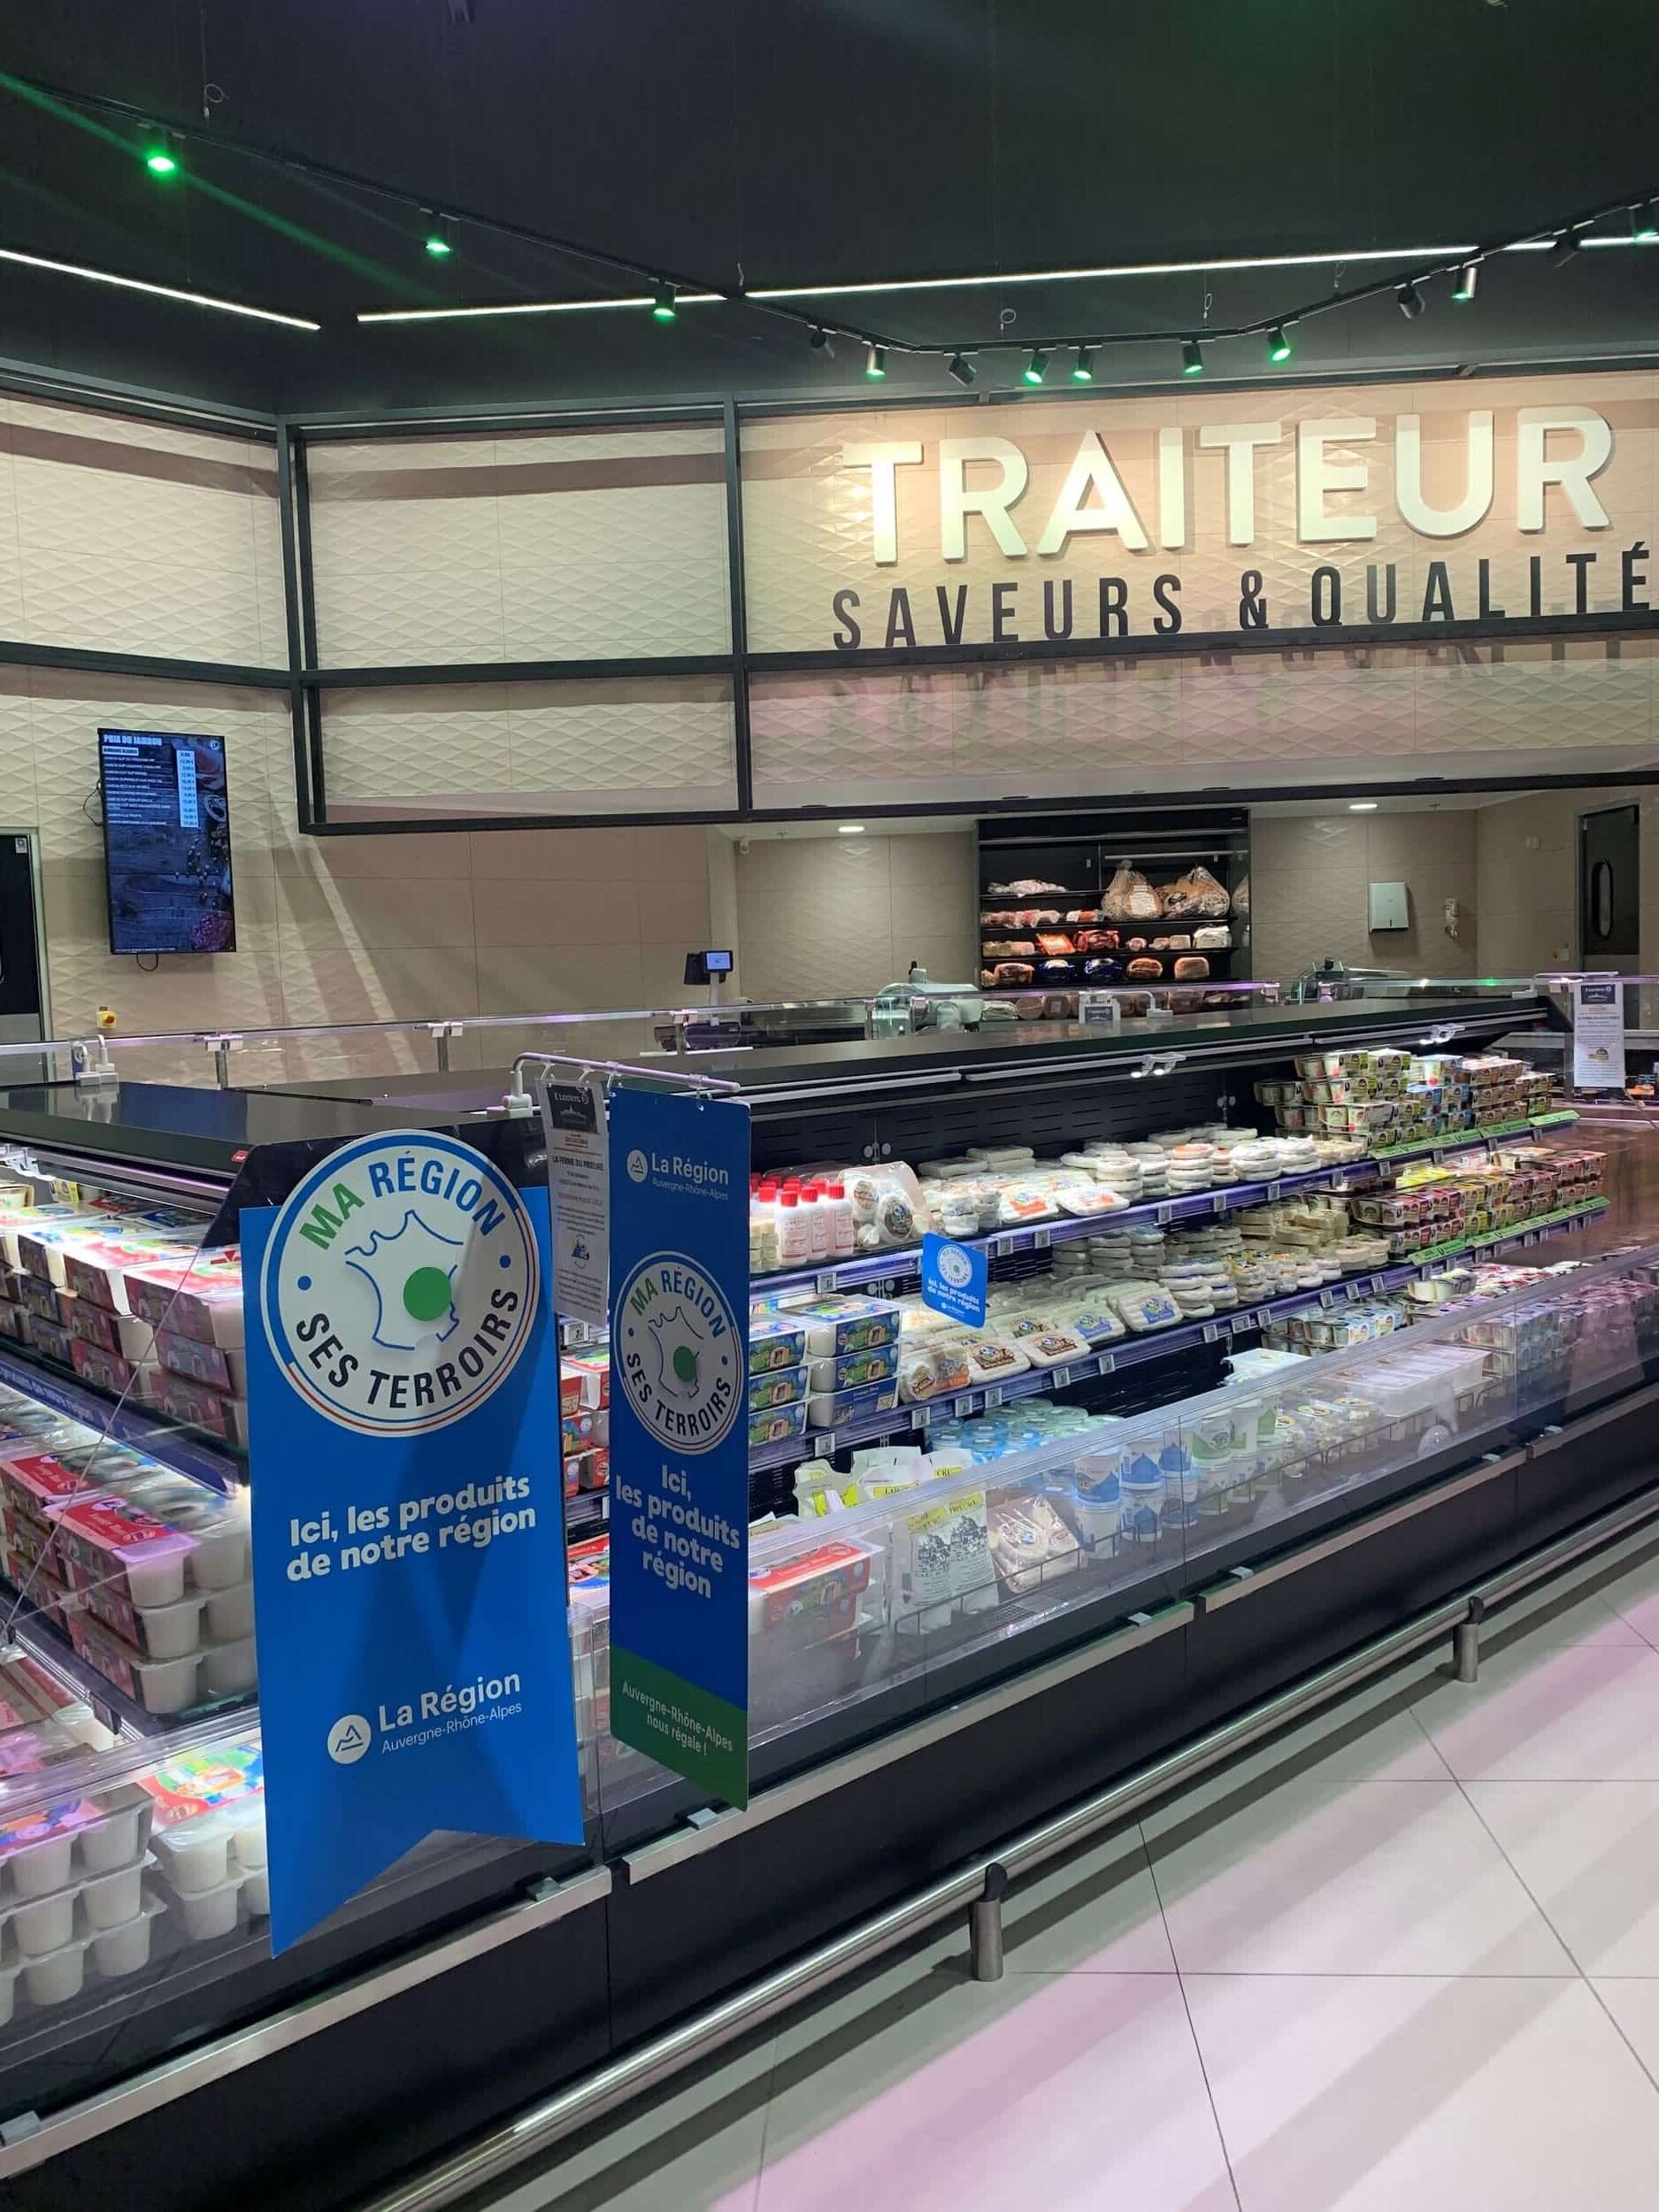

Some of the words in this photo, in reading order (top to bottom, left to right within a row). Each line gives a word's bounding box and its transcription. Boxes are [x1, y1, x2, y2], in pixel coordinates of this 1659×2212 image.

[843, 404, 1612, 565] TRAITEUR
[833, 573, 1182, 649] SAVEURS
[1240, 569, 1269, 630] &
[1311, 541, 1651, 626] QUALITÉ
[299, 1182, 365, 1251] MA
[368, 1149, 506, 1237] RÉGION
[651, 1152, 669, 1173] La
[672, 1156, 729, 1186] Région
[630, 1277, 659, 1317] MA
[660, 1265, 726, 1339] RÉGION
[296, 1313, 359, 1387] SES
[367, 1288, 518, 1409] TERROIRS
[626, 1352, 653, 1403] SES
[655, 1377, 732, 1437] TERROIRS
[289, 1510, 339, 1547] Ici,
[348, 1506, 390, 1534] les
[399, 1475, 531, 1531] produits
[616, 1474, 643, 1508] les
[648, 1494, 741, 1549] produits
[662, 1464, 692, 1502] Ici,
[286, 1551, 331, 1582] de
[341, 1532, 429, 1571] notre
[439, 1507, 536, 1548] région
[632, 1515, 659, 1544] de
[664, 1530, 724, 1572] notre
[642, 1549, 711, 1600] région
[378, 1703, 413, 1732] La
[420, 1673, 521, 1720] Région
[380, 1701, 523, 1755] Auvergne-Rhône-Alpes
[622, 1681, 733, 1752] Auvergne-Rhône-Alpes
[647, 1712, 669, 1735] nous
[671, 1727, 702, 1753] régale
